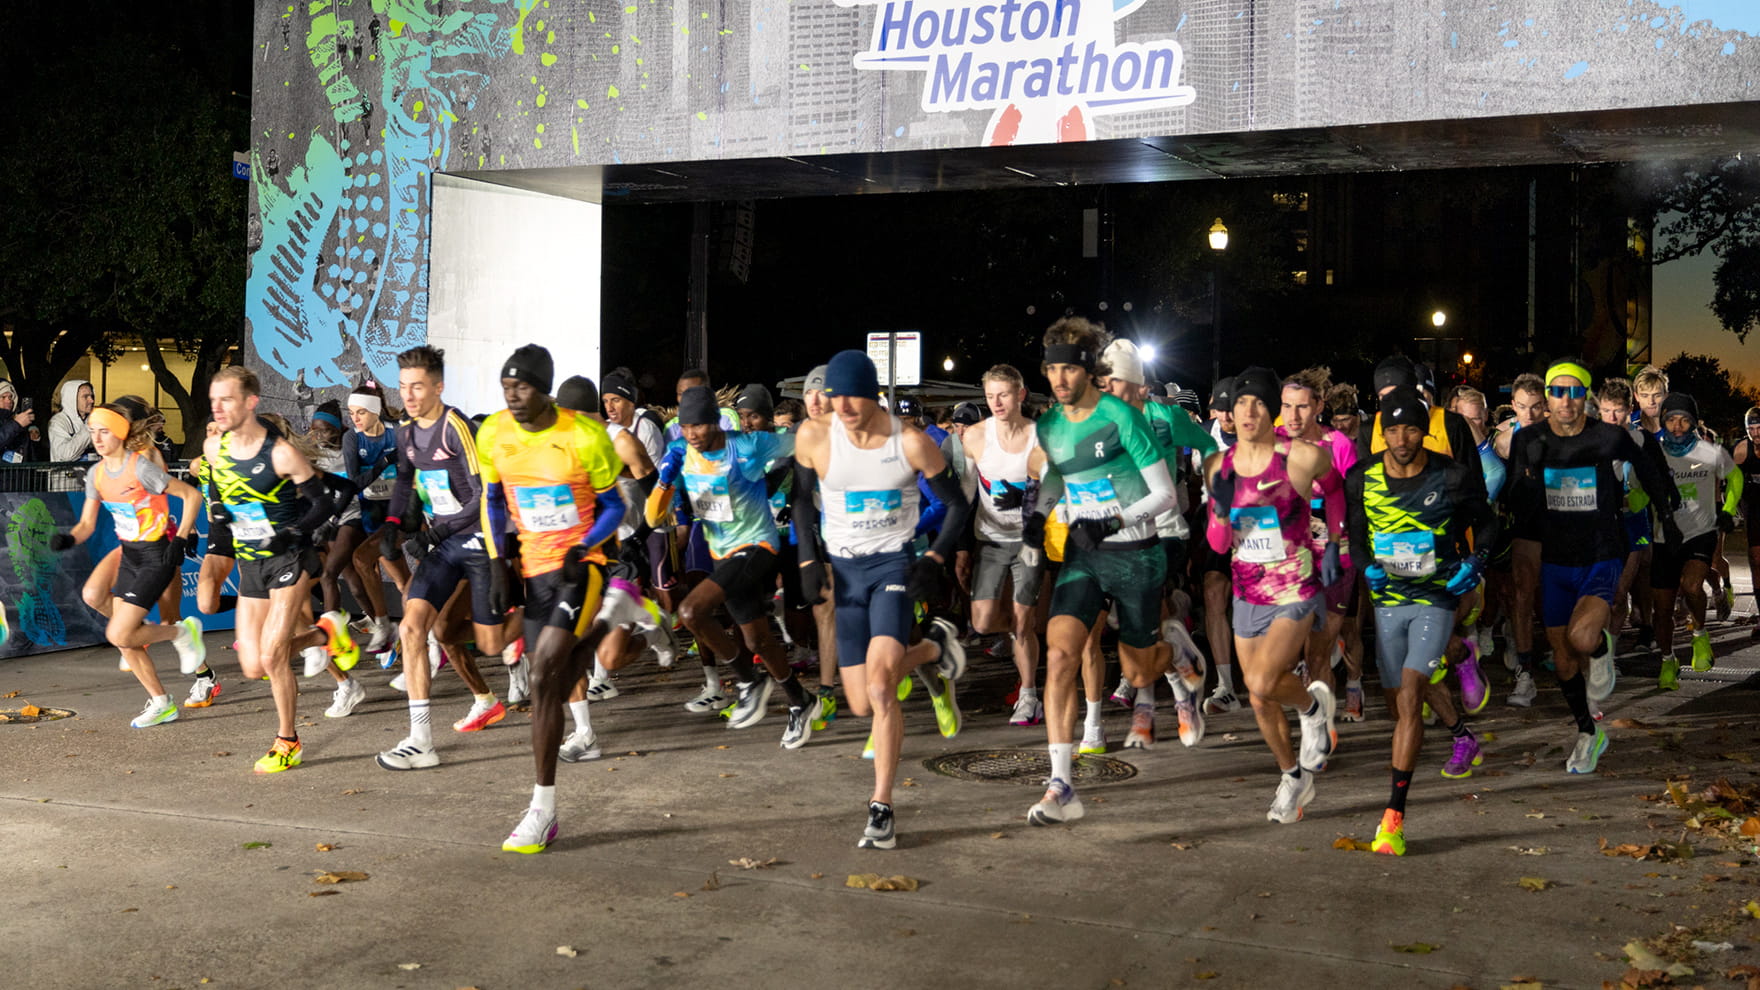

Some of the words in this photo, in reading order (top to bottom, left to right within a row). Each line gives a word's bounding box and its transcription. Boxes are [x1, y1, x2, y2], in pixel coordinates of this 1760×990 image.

[877, 0, 1081, 52] Houston
[929, 40, 1174, 104] Marathon
[1675, 470, 1709, 480] SUAREZ
[1547, 495, 1566, 507] DIEGO
[1567, 494, 1595, 507] ESTRADA
[1238, 537, 1273, 550] MANTZ
